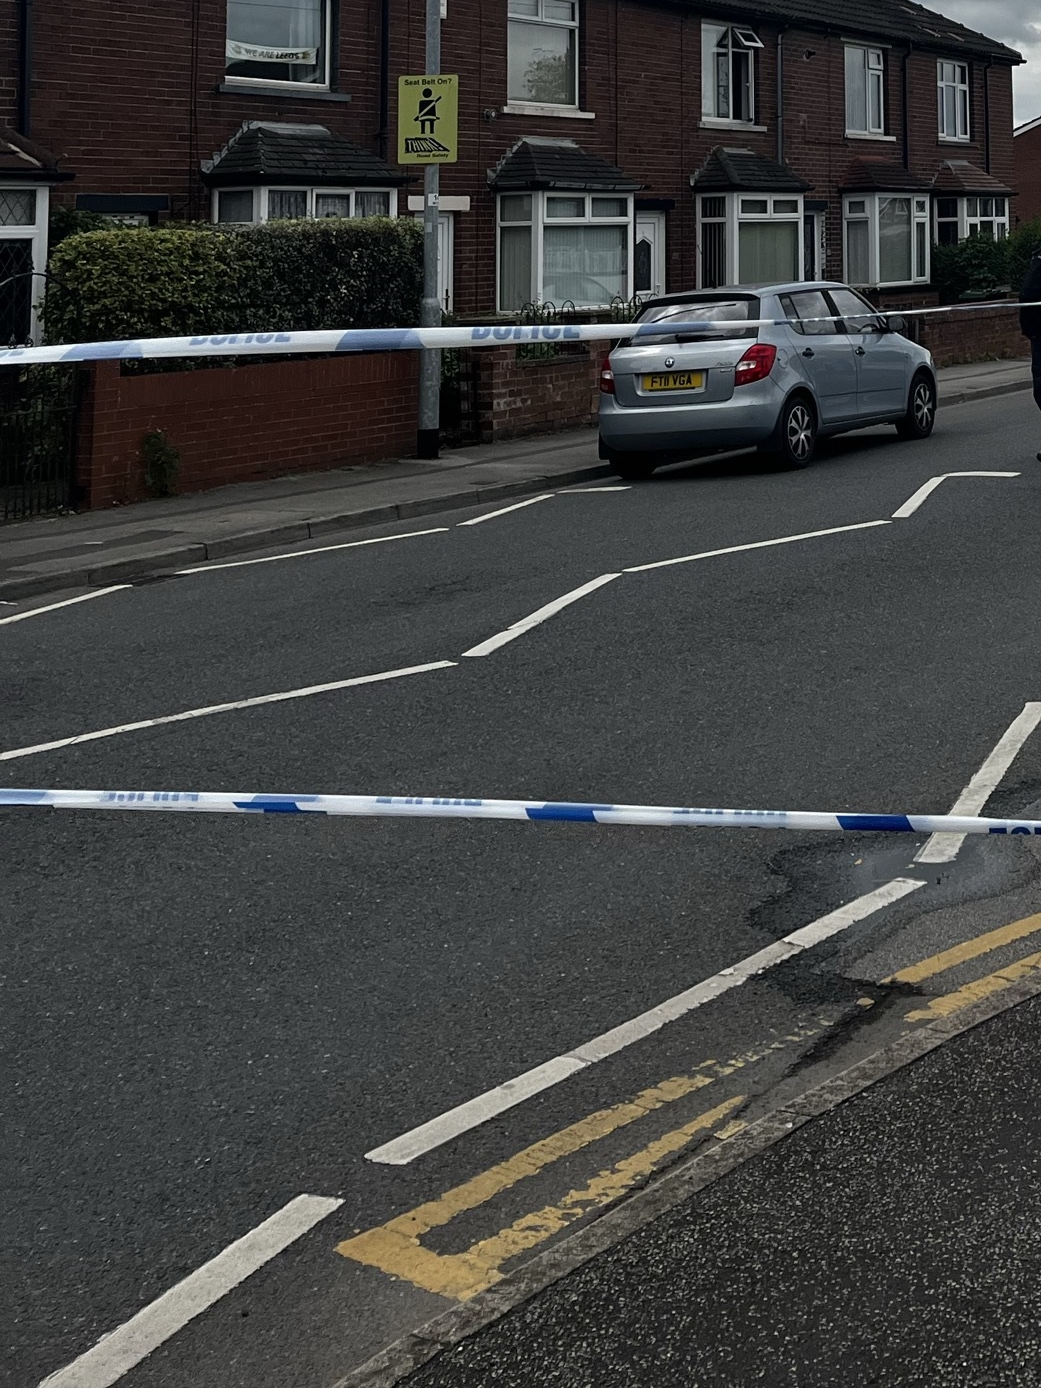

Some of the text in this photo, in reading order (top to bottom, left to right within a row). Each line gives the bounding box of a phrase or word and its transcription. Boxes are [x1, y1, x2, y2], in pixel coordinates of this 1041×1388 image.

[244, 48, 300, 60] WE ARE LEEDS
[421, 78, 436, 86] Belt
[650, 374, 693, 387] FT11 VGA
